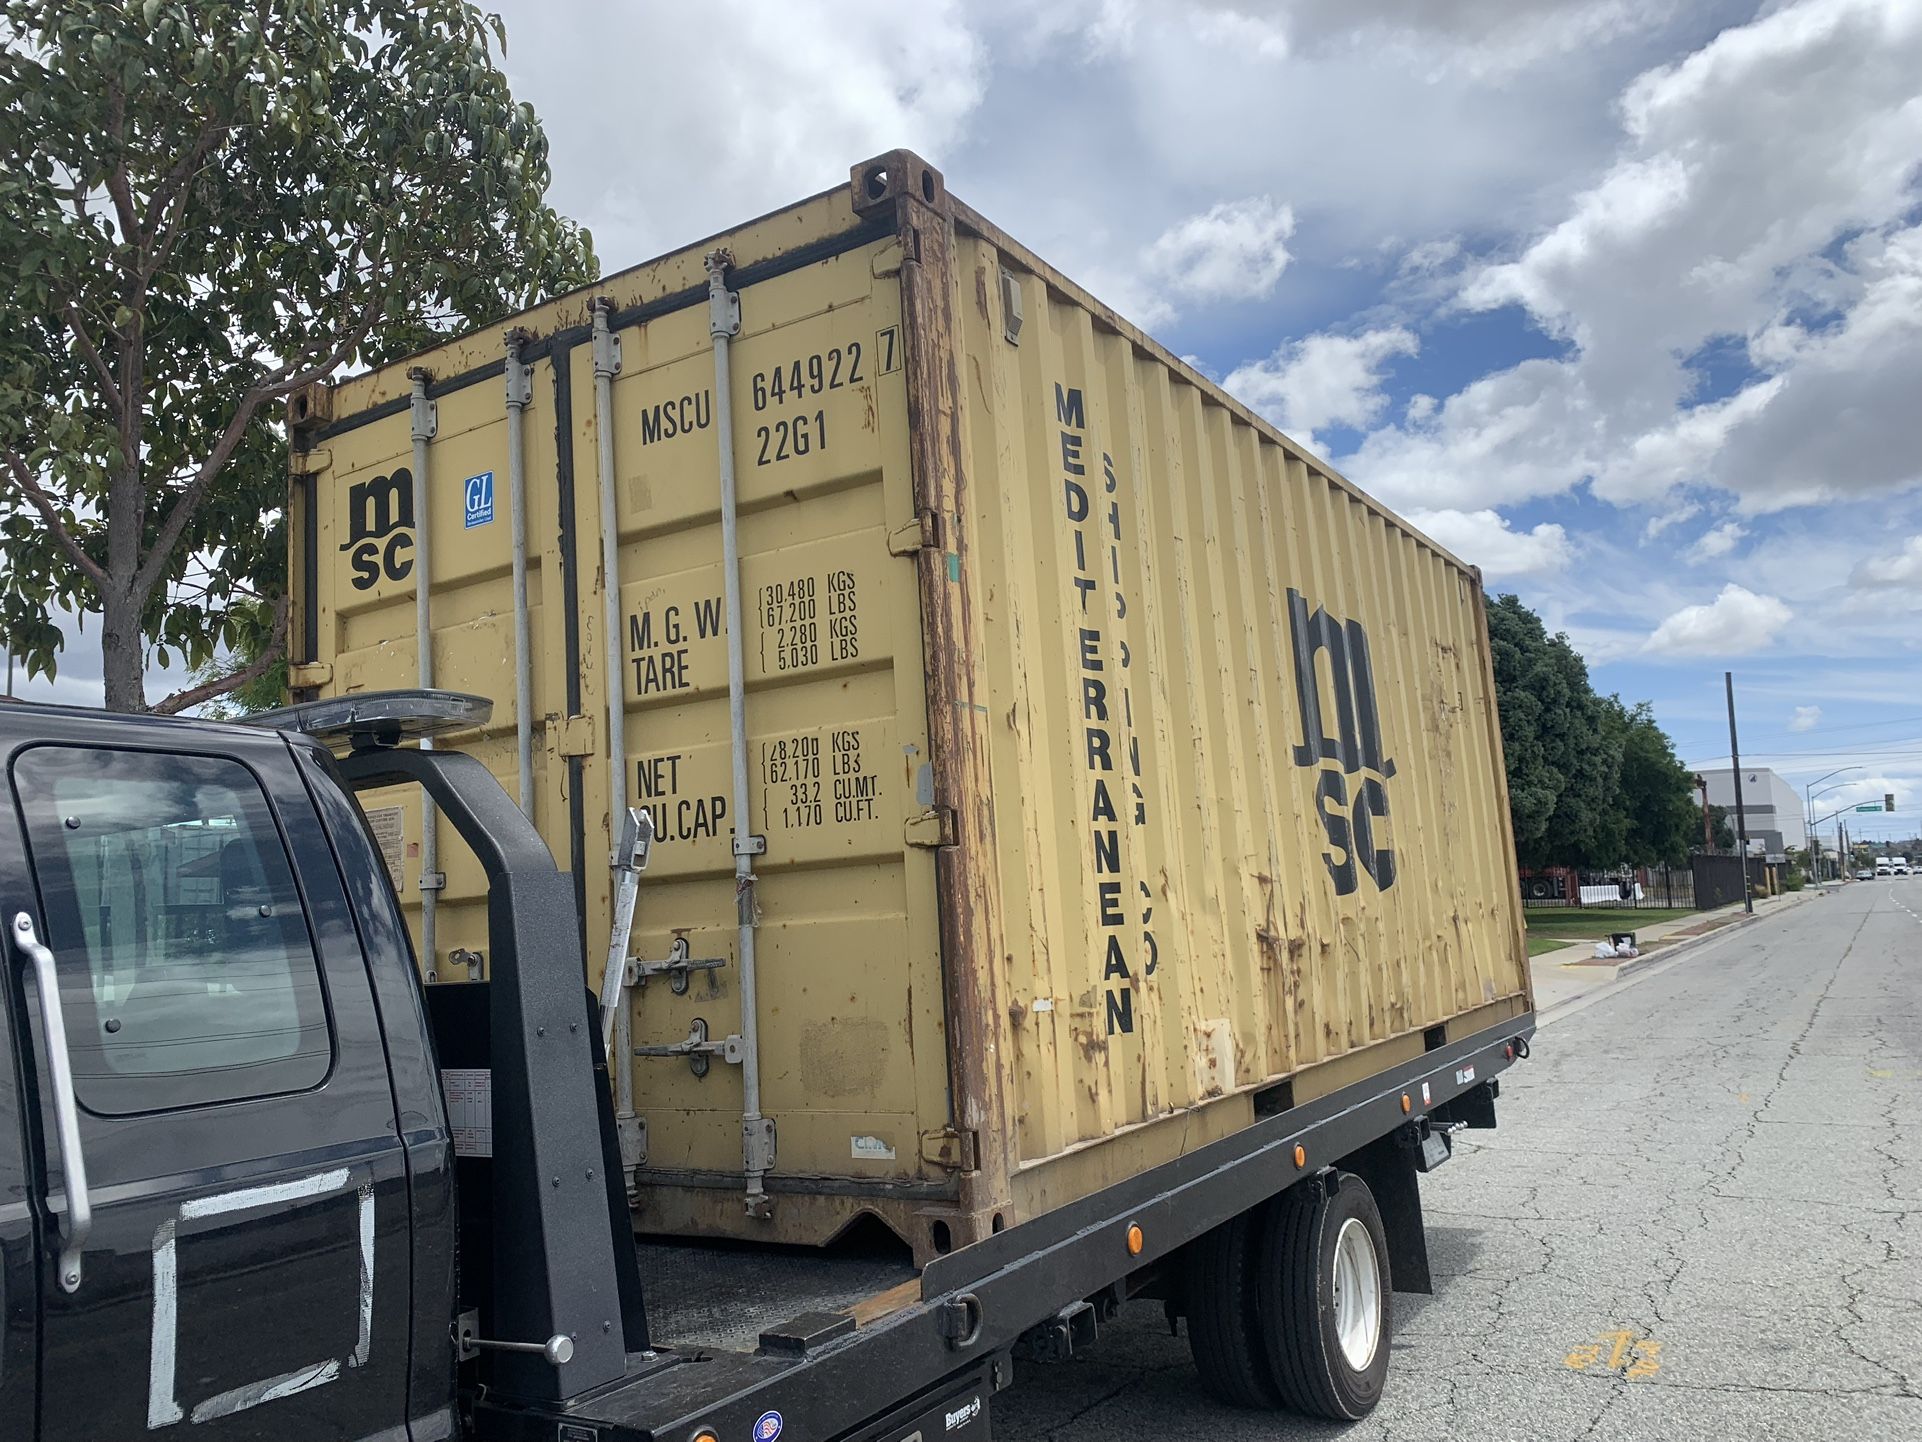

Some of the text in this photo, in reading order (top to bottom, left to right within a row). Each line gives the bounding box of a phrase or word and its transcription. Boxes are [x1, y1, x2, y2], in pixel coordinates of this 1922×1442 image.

[641, 328, 895, 446] MSCU 644922 7
[757, 410, 827, 467] 22G1
[466, 475, 492, 512] GL
[466, 507, 492, 521] Certified
[827, 570, 856, 594] KGS
[828, 590, 857, 616] LBS
[829, 614, 858, 640] KGS
[830, 636, 859, 662] LBS
[631, 648, 690, 696] TARE
[1055, 381, 1134, 1035] MEDITERRANEAN
[831, 730, 860, 754] KGS
[637, 755, 682, 800] NET
[832, 753, 861, 776] LBS
[790, 781, 822, 806] 33.2
[640, 795, 736, 844] U.CAP.
